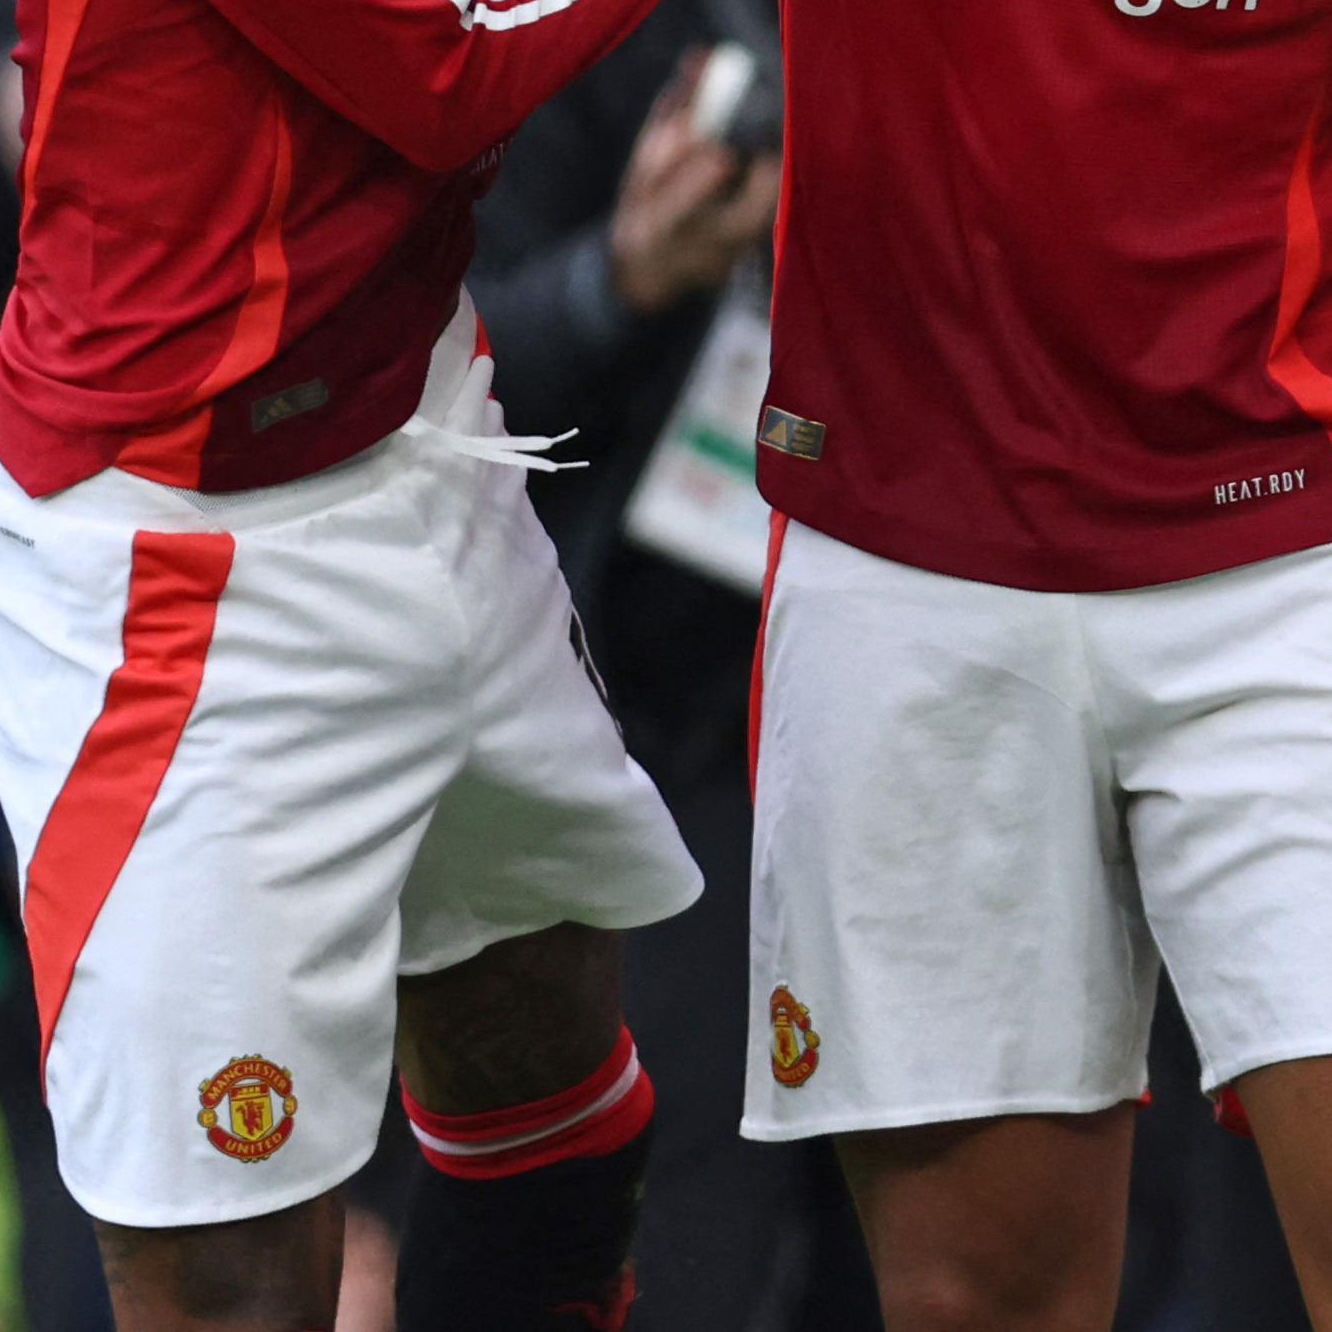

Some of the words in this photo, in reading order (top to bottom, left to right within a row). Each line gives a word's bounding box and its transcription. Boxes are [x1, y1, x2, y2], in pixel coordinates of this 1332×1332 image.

[1214, 468, 1306, 505] HEAT.RDY
[208, 1063, 287, 1100] MANCHESTER
[225, 1132, 282, 1154] UNITED
